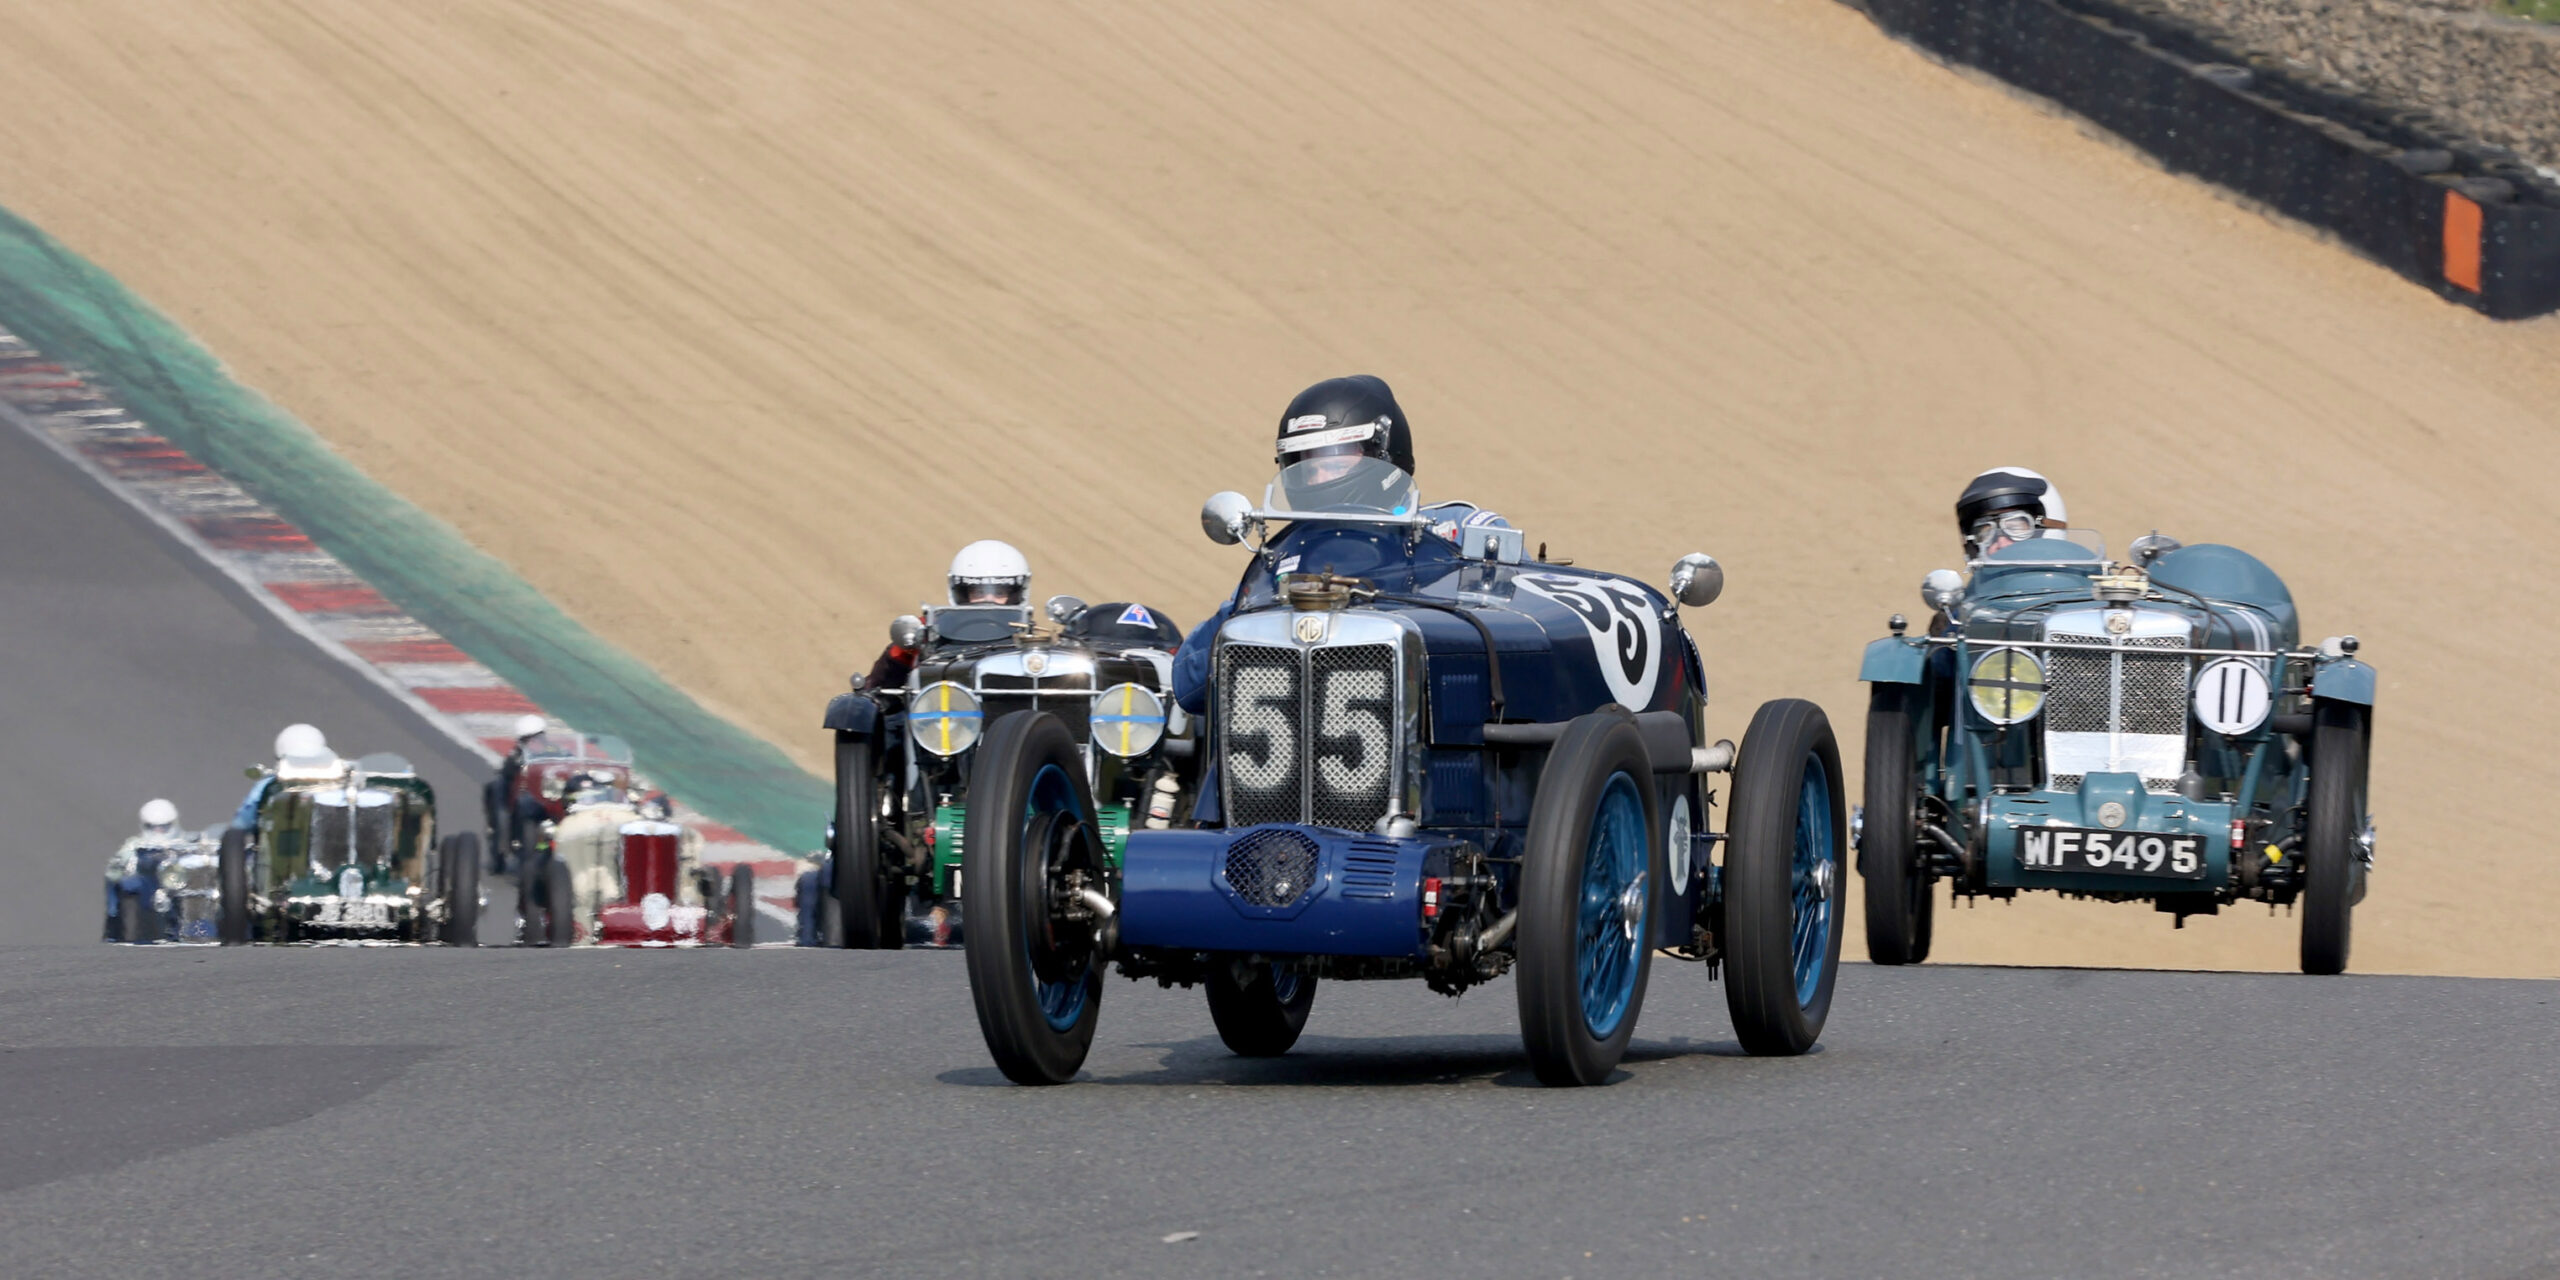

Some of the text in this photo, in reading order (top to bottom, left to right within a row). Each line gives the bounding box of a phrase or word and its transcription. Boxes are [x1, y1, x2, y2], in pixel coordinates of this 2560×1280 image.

[1299, 618, 1321, 640] MG
[1524, 578, 1648, 686] 55
[1229, 667, 1388, 792] 55
[2218, 666, 2248, 724] 11
